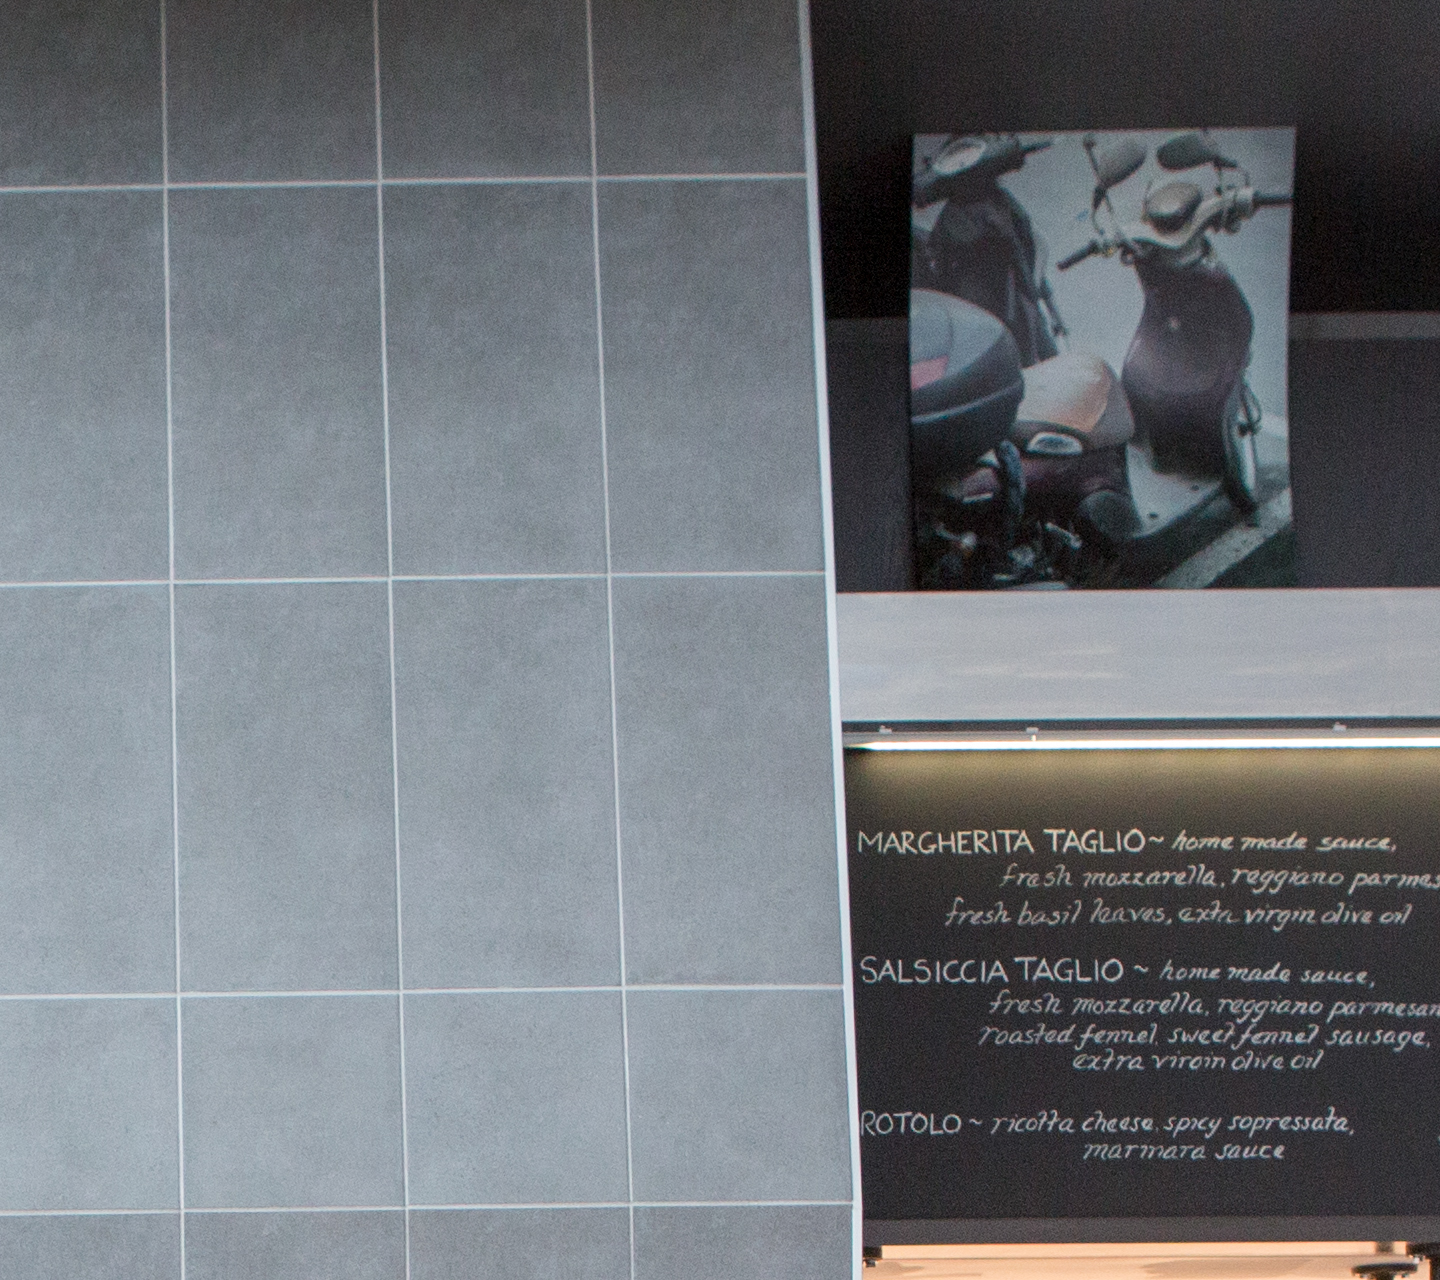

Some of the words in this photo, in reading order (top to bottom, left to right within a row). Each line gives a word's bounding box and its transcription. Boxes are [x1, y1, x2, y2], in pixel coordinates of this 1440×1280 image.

[857, 830, 1034, 854] MARGHERITA
[1172, 829, 1234, 851] home
[1241, 831, 1308, 850] made
[999, 862, 1072, 888] fresh
[1232, 866, 1344, 895] reggiano
[945, 897, 1011, 926] fresh
[1017, 900, 1082, 926] basil
[1244, 904, 1317, 932] virgin
[1321, 902, 1372, 925] olive
[1378, 903, 1412, 925] oil
[860, 955, 1010, 985] SALSICCIA
[1014, 956, 1124, 983] TAGLIO
[1158, 959, 1221, 981] home
[1226, 962, 1291, 983] made
[988, 989, 1063, 1016] fresh
[1218, 995, 1323, 1024] reggiano
[978, 1022, 1076, 1046] roasted
[1168, 1022, 1236, 1045] sweet
[1230, 1022, 1320, 1050] fennel
[1072, 1048, 1145, 1071] extra
[1230, 1049, 1284, 1071] olive
[1290, 1048, 1324, 1070] oil
[860, 1110, 962, 1137] ROTOLO
[990, 1109, 1075, 1134] ricotta
[1163, 1115, 1221, 1139] spicy
[1215, 1143, 1286, 1160] sauce
